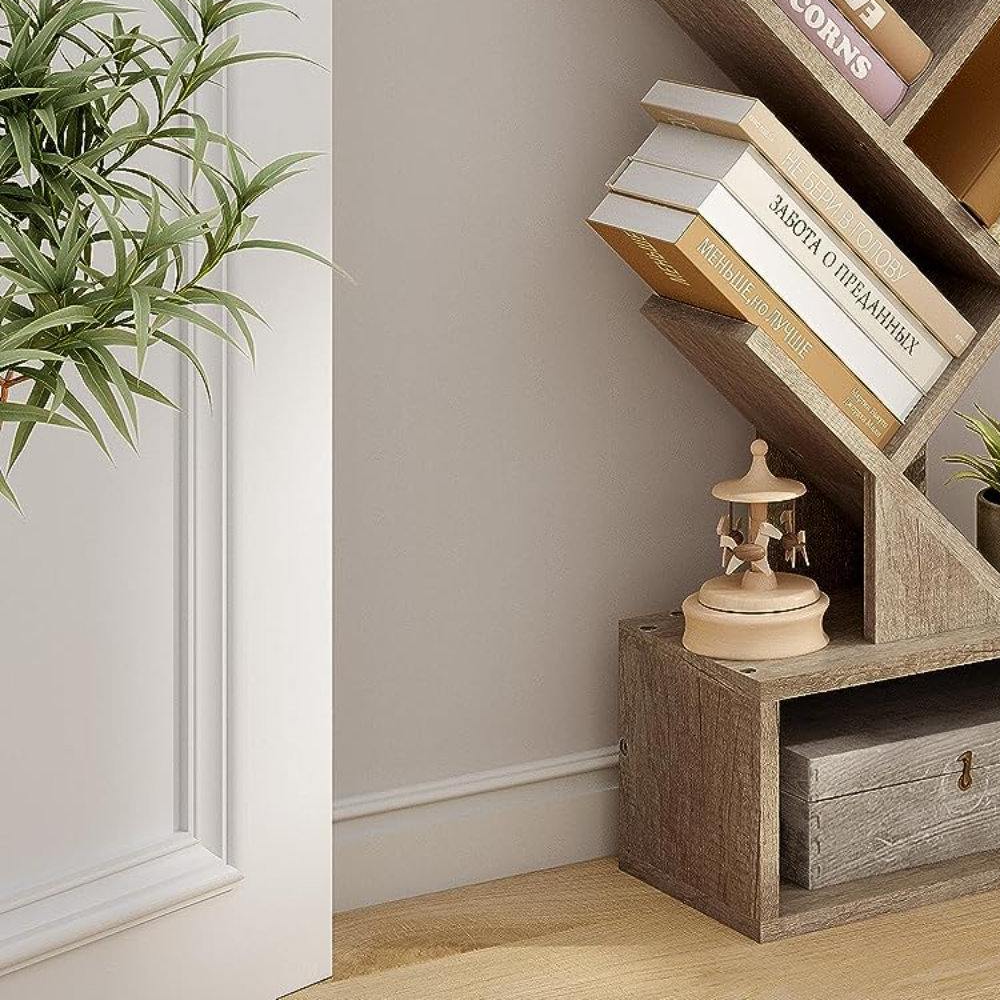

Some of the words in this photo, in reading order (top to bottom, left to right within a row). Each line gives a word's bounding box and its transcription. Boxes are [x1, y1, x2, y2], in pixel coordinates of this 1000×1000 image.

[767, 194, 825, 255] ЗАБОТА
[819, 249, 839, 269] О
[832, 263, 922, 357] ПРЕДАННЫХ
[779, 149, 809, 179] НЕ
[800, 171, 844, 216] БЕРИ
[836, 209, 856, 229] В
[846, 221, 909, 286] ГОЛОВУ
[764, 308, 814, 359] ЛУЧШЕ
